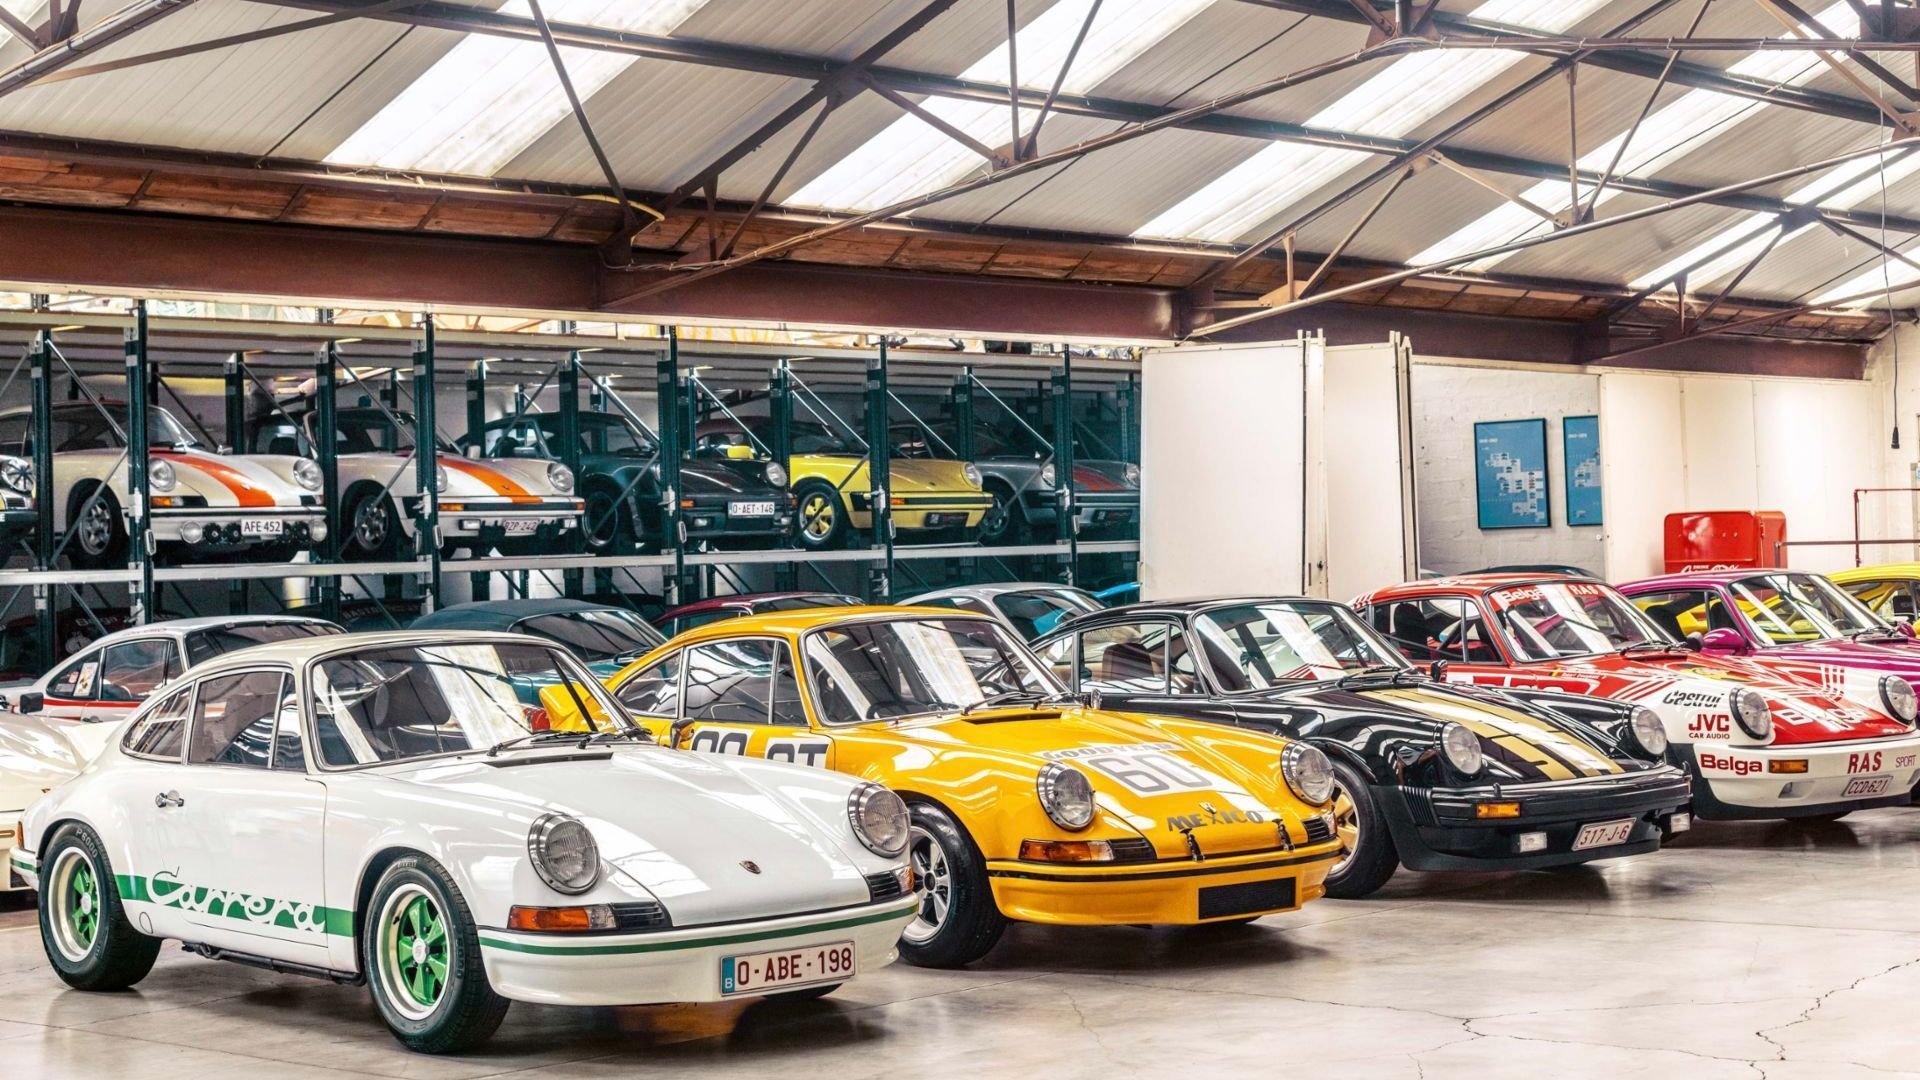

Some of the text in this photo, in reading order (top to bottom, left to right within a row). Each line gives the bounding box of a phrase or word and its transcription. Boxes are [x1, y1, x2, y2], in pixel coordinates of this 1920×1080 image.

[244, 521, 281, 532] AFE 452
[1569, 584, 1598, 595] RAS
[1688, 713, 1730, 732] JVC
[1688, 732, 1731, 740] CAR AUDIO
[1700, 753, 1763, 776] Belga
[1847, 751, 1917, 774] RAS SPORT
[1087, 753, 1213, 793] 60
[1167, 810, 1264, 832] MEXICO
[145, 866, 327, 934] Carrera
[724, 977, 733, 989] B
